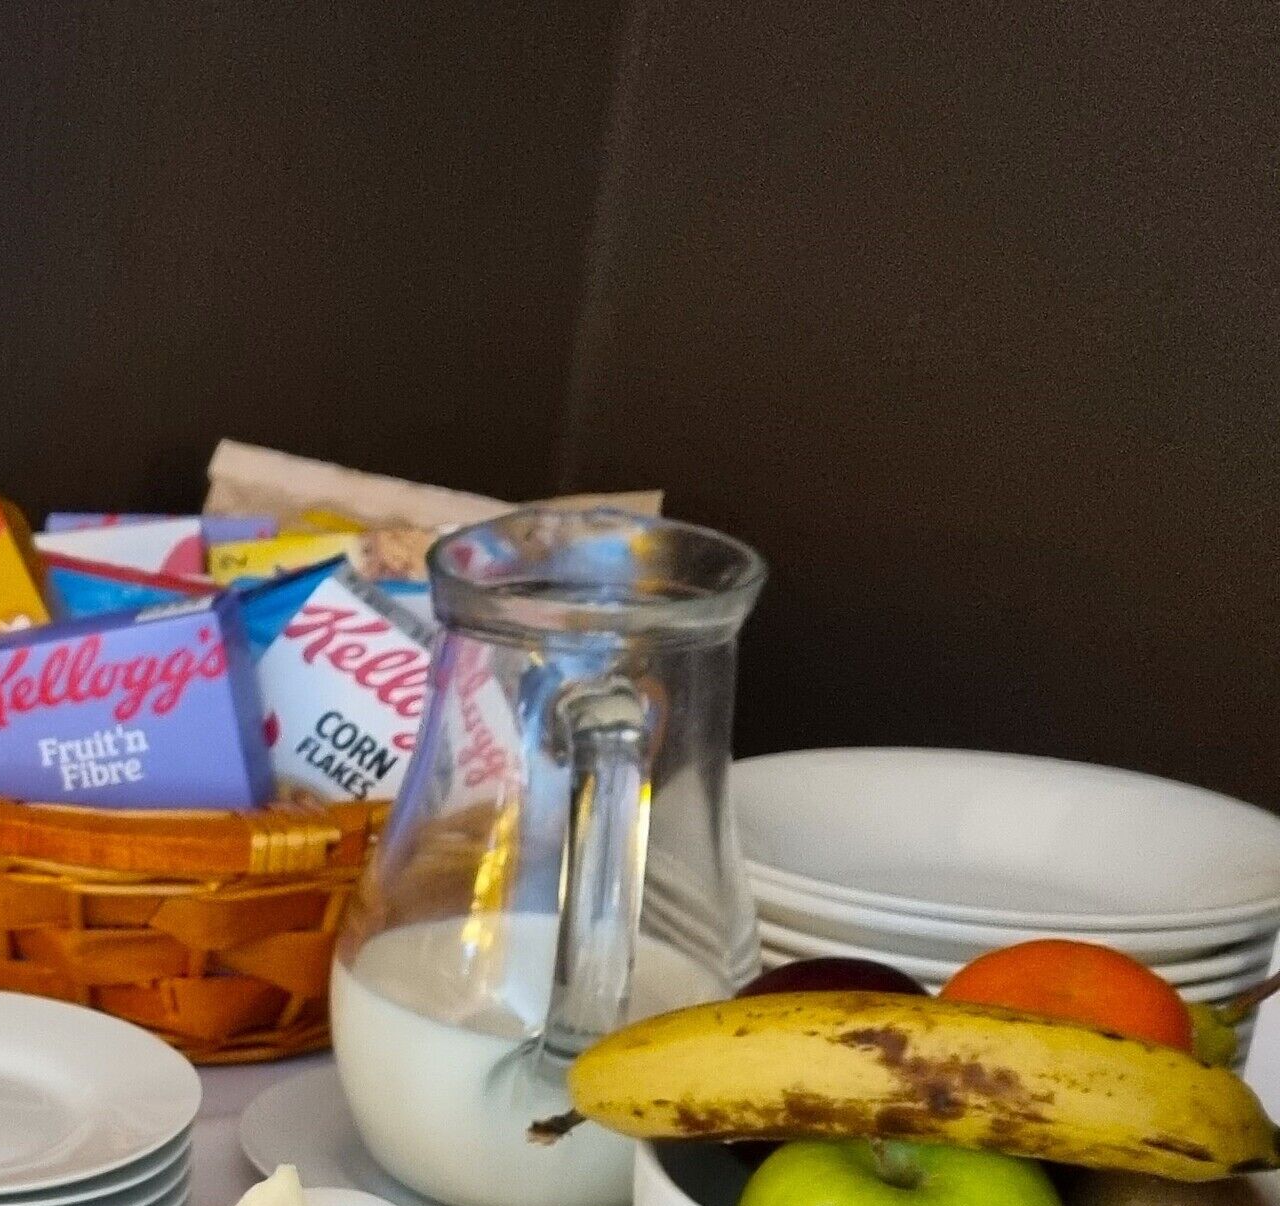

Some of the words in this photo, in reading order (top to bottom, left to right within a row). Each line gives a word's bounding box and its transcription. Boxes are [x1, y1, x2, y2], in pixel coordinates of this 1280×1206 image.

[284, 603, 429, 750] Kello
[60, 757, 145, 791] Fibre
[295, 736, 376, 800] FLAKES
[315, 710, 399, 780] CORN
